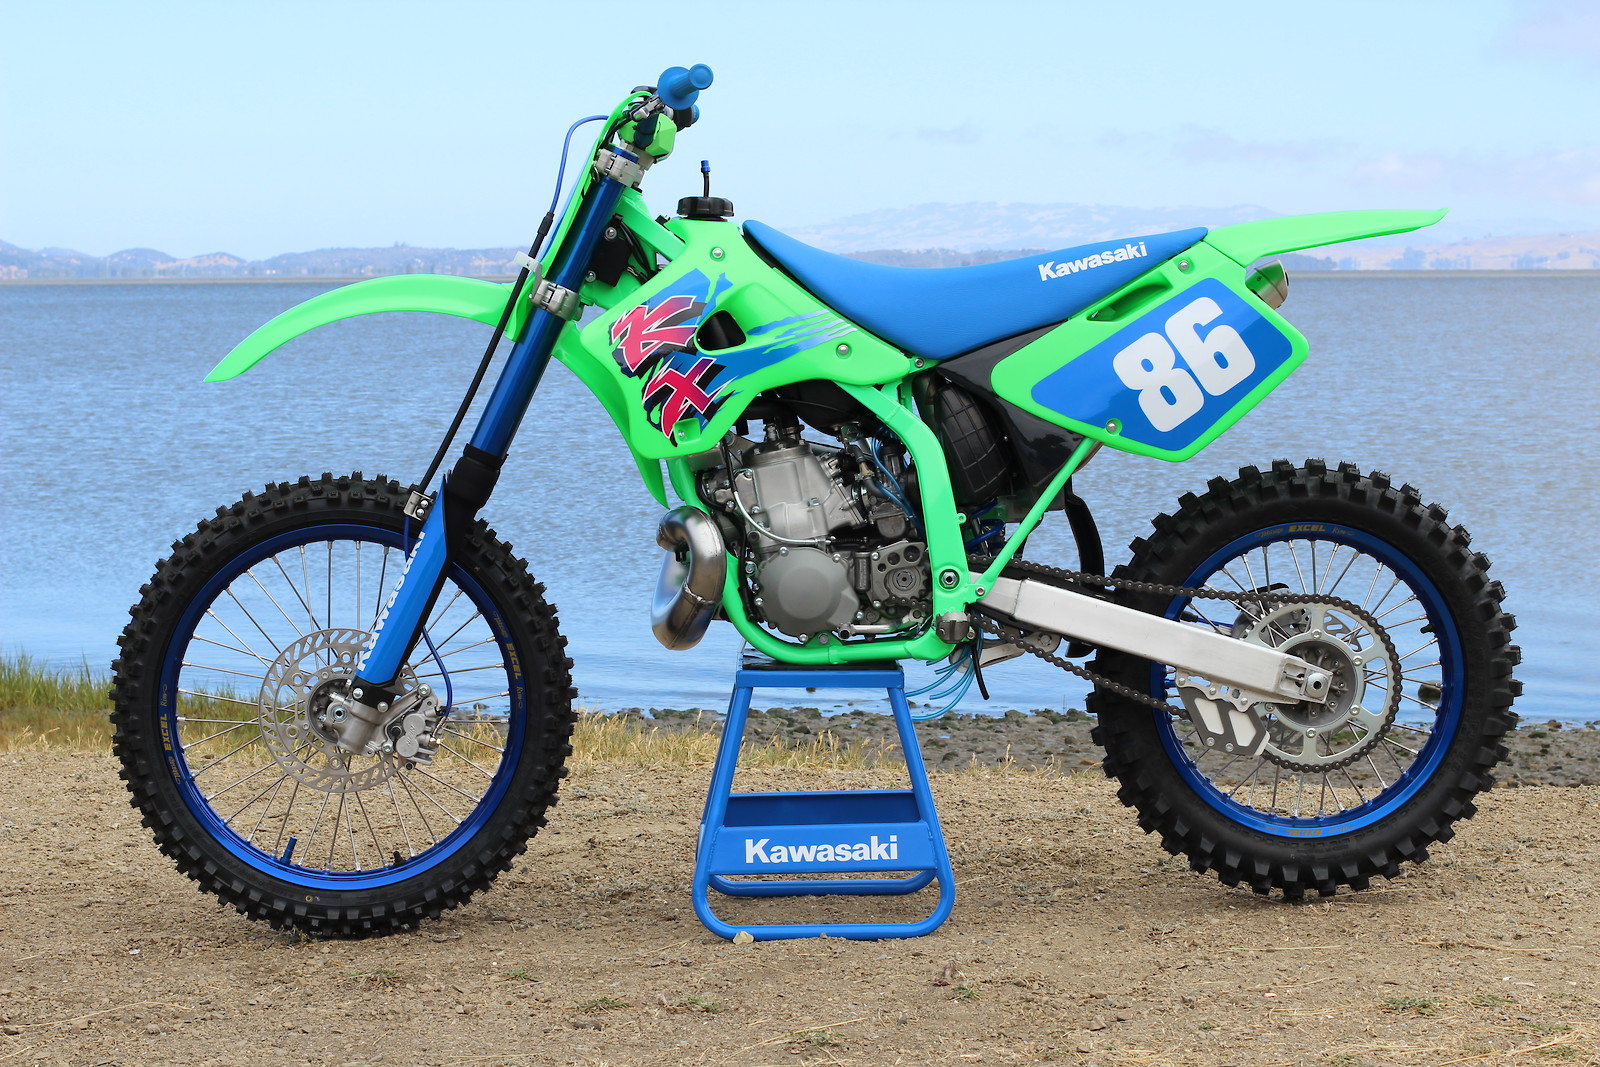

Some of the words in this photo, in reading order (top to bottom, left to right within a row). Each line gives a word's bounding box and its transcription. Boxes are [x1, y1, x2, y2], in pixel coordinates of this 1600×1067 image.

[1037, 242, 1147, 281] Kawasaki
[1113, 297, 1255, 432] 86
[1288, 524, 1325, 533] EXCEL
[506, 642, 521, 679] EXCEL
[160, 713, 173, 751] EXCEL
[745, 835, 898, 863] Kawasaki
